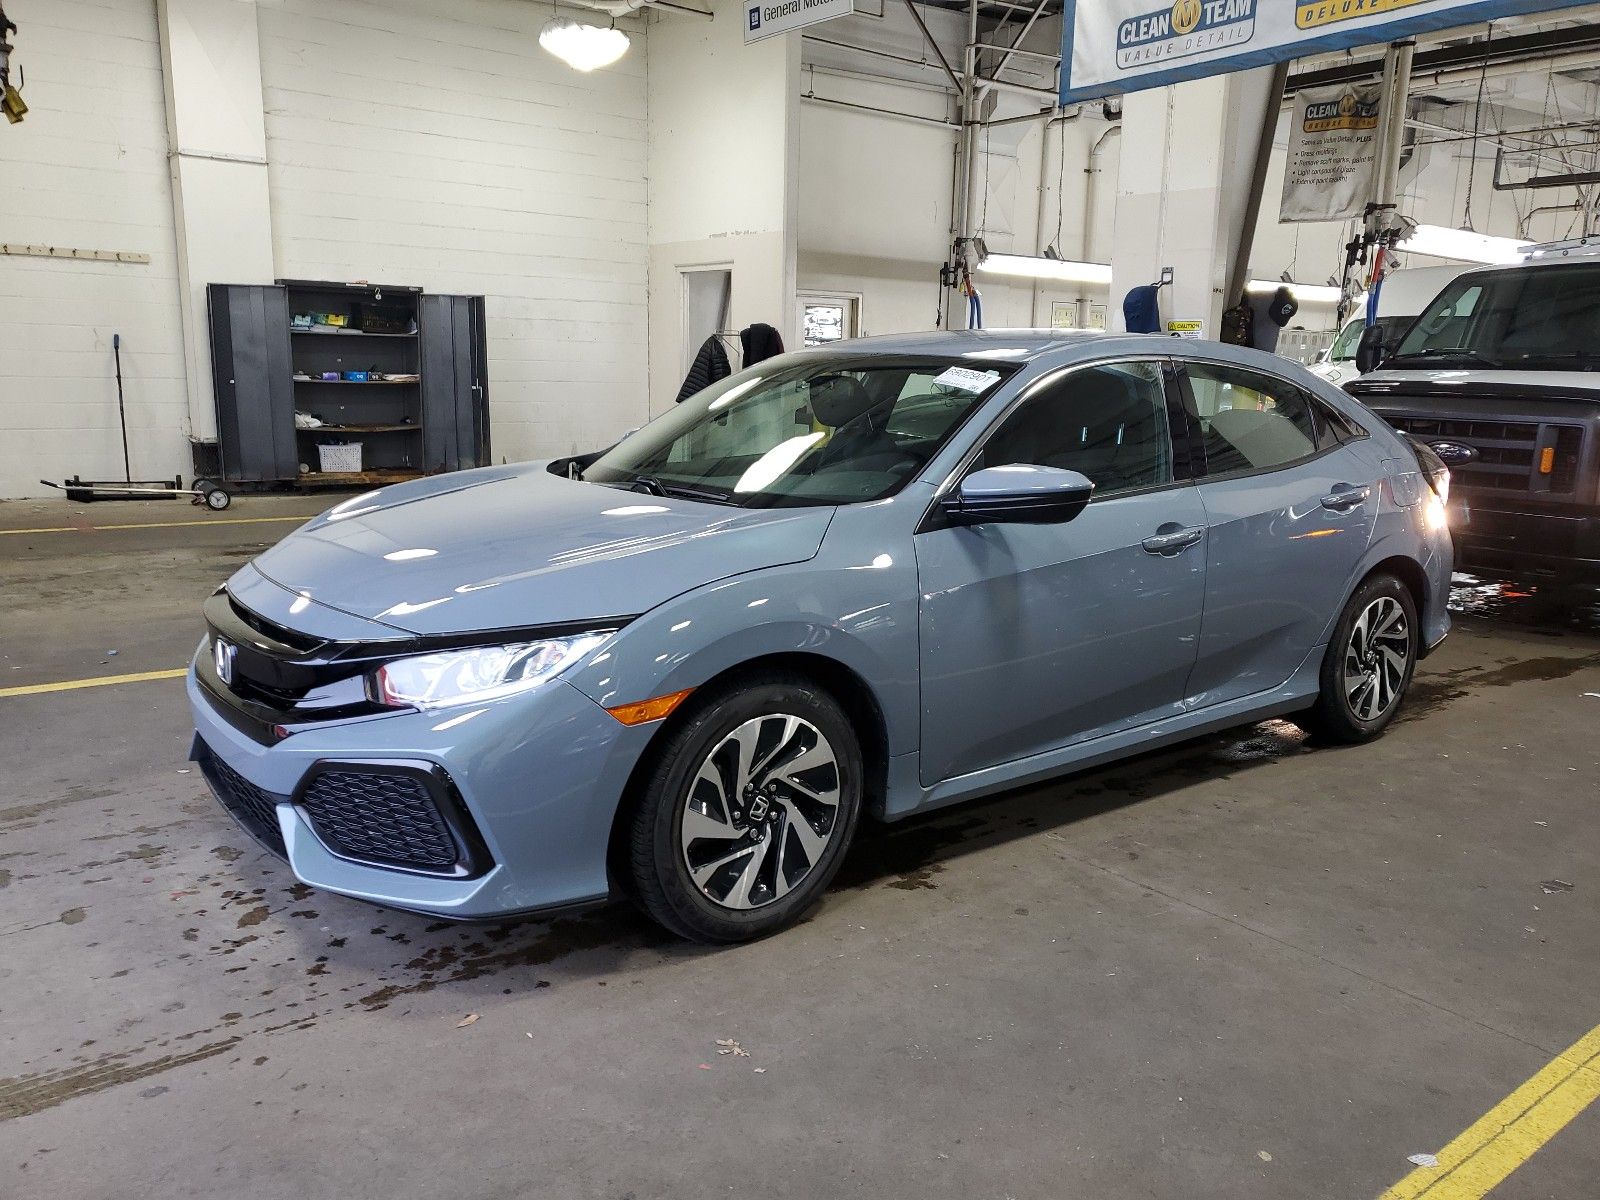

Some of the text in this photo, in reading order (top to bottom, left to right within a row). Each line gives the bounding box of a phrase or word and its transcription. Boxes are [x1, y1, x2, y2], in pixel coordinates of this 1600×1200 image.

[764, 0, 800, 21] General
[1305, 0, 1377, 21] DELUXE
[1120, 13, 1169, 44] CLEAN
[1204, 0, 1251, 25] TEAM
[1124, 27, 1243, 62] VALUE DETAIL
[1307, 103, 1338, 119] CLEAN
